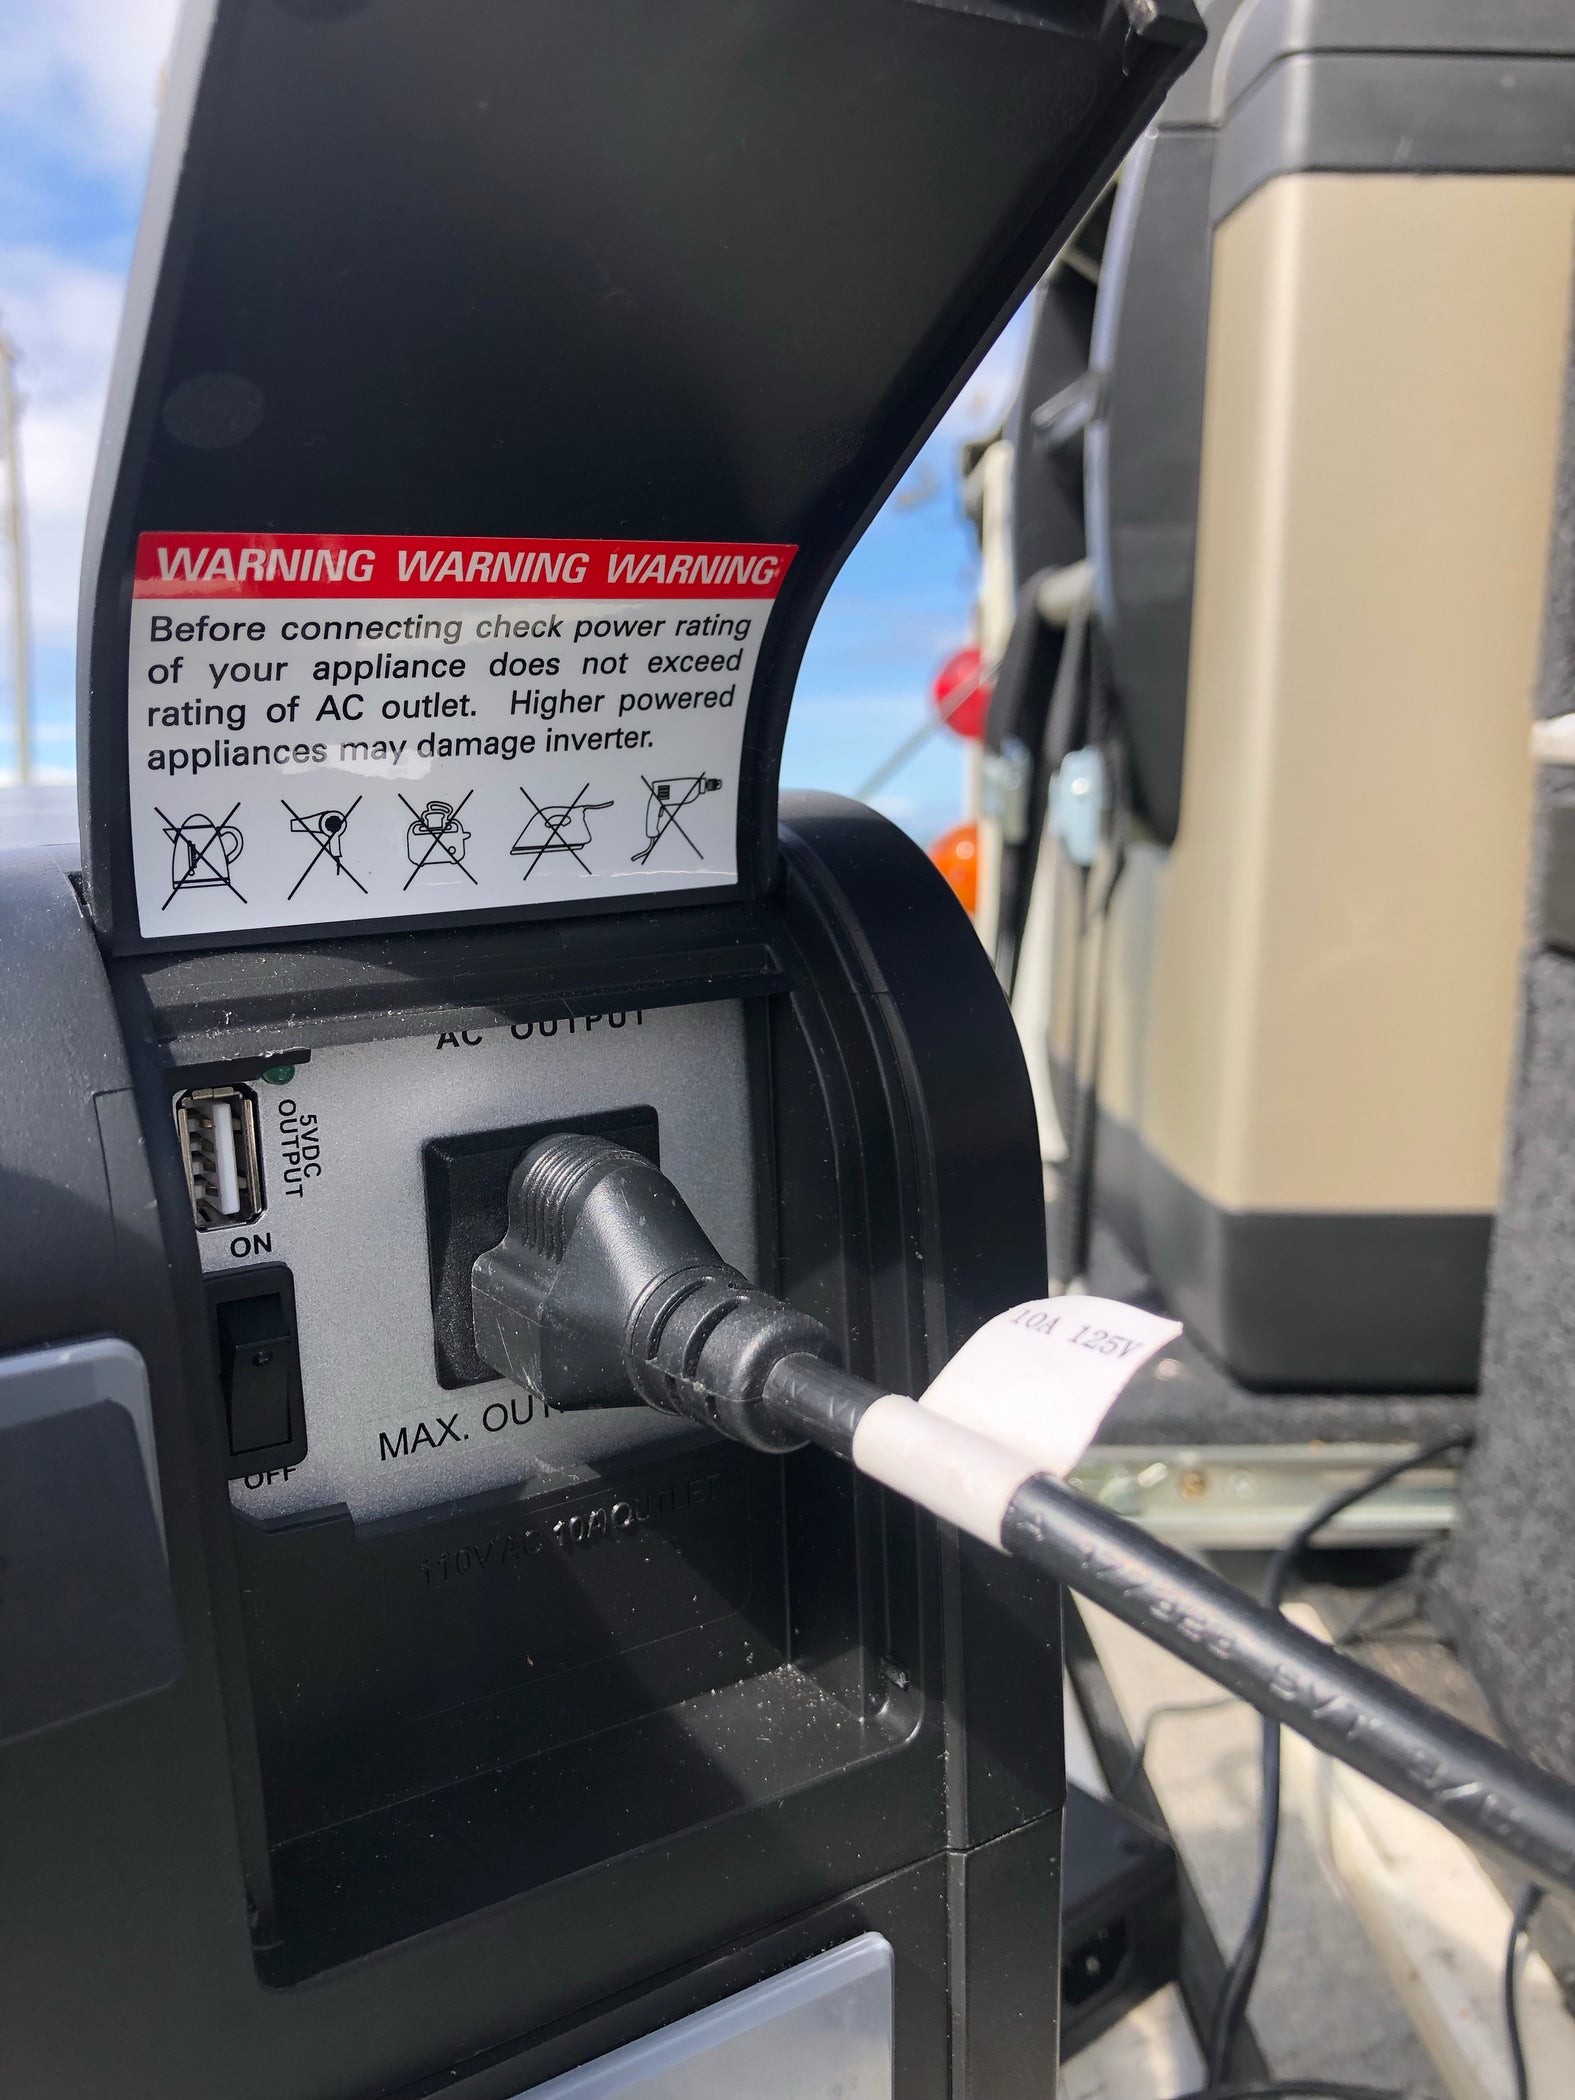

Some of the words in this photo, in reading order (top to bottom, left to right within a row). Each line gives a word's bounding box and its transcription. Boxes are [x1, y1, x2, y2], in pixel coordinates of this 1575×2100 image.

[157, 547, 376, 582] WARNING
[398, 550, 590, 583] WARNING
[606, 553, 780, 585] WARNING
[150, 615, 266, 642] Before
[281, 614, 463, 645] connecting
[476, 614, 564, 638] check
[573, 619, 666, 643] power
[675, 613, 752, 641] rating
[148, 656, 184, 684] of
[208, 660, 288, 689] your
[312, 653, 466, 686] appliance
[489, 652, 560, 676] does
[582, 652, 629, 675] not
[647, 648, 744, 673] exceed
[148, 698, 246, 731] rating
[266, 695, 300, 723] of
[315, 693, 364, 721] AC
[381, 692, 477, 720] outlet.
[510, 689, 605, 720] Higher
[618, 684, 736, 717] powered
[147, 739, 327, 776] appliances
[340, 738, 407, 766] may
[417, 732, 536, 761] damage
[545, 727, 654, 753] inverter.
[436, 1030, 483, 1050] AC
[278, 1099, 303, 1198] OUTPUT
[299, 1114, 322, 1178] 5VDC
[230, 1232, 272, 1258] ON
[1009, 1308, 1062, 1335] 10A
[1067, 1324, 1145, 1360] 125V
[379, 1413, 469, 1461] MAX.
[482, 1394, 565, 1433] OU
[244, 1467, 296, 1490] OFF
